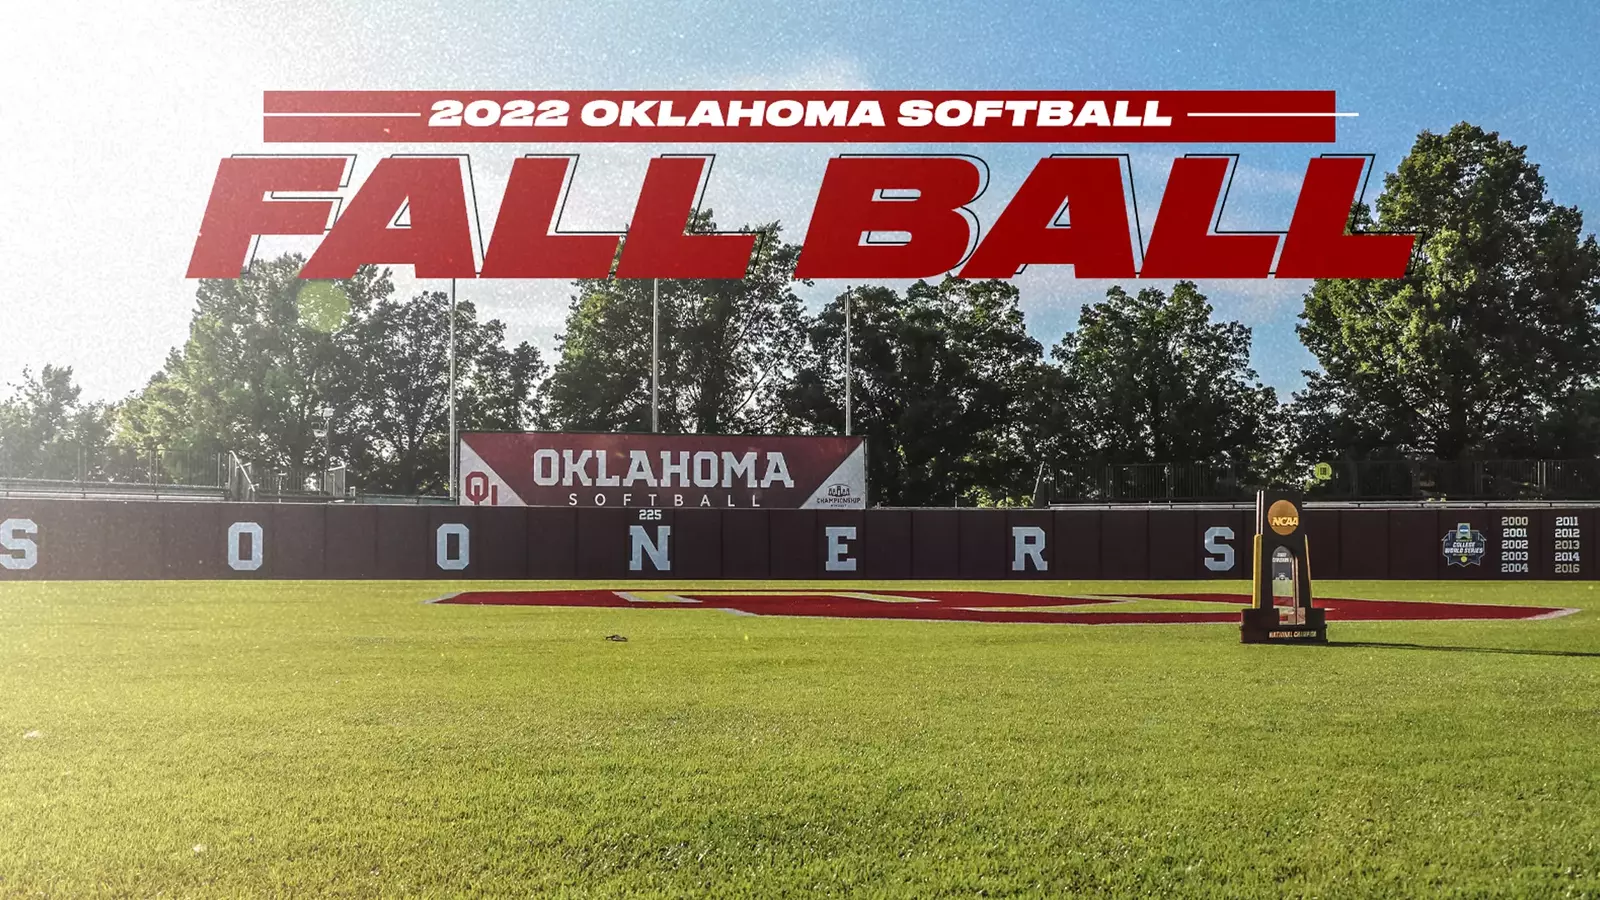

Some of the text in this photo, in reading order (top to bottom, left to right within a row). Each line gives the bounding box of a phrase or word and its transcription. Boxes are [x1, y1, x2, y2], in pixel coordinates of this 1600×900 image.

[533, 449, 795, 488] OKLAHOMA
[638, 509, 662, 521] 225
[1272, 516, 1299, 527] NCAA
[1501, 516, 1529, 525] 2000
[1555, 516, 1579, 526] 2011
[1502, 528, 1528, 538] 2001
[1554, 528, 1580, 538] 2012
[1501, 540, 1529, 550] 2002
[1554, 540, 1580, 550] 2013
[1501, 552, 1529, 562] 2003
[1554, 552, 1580, 562] 2014
[1501, 563, 1529, 573] 2004
[1554, 563, 1580, 573] 2016
